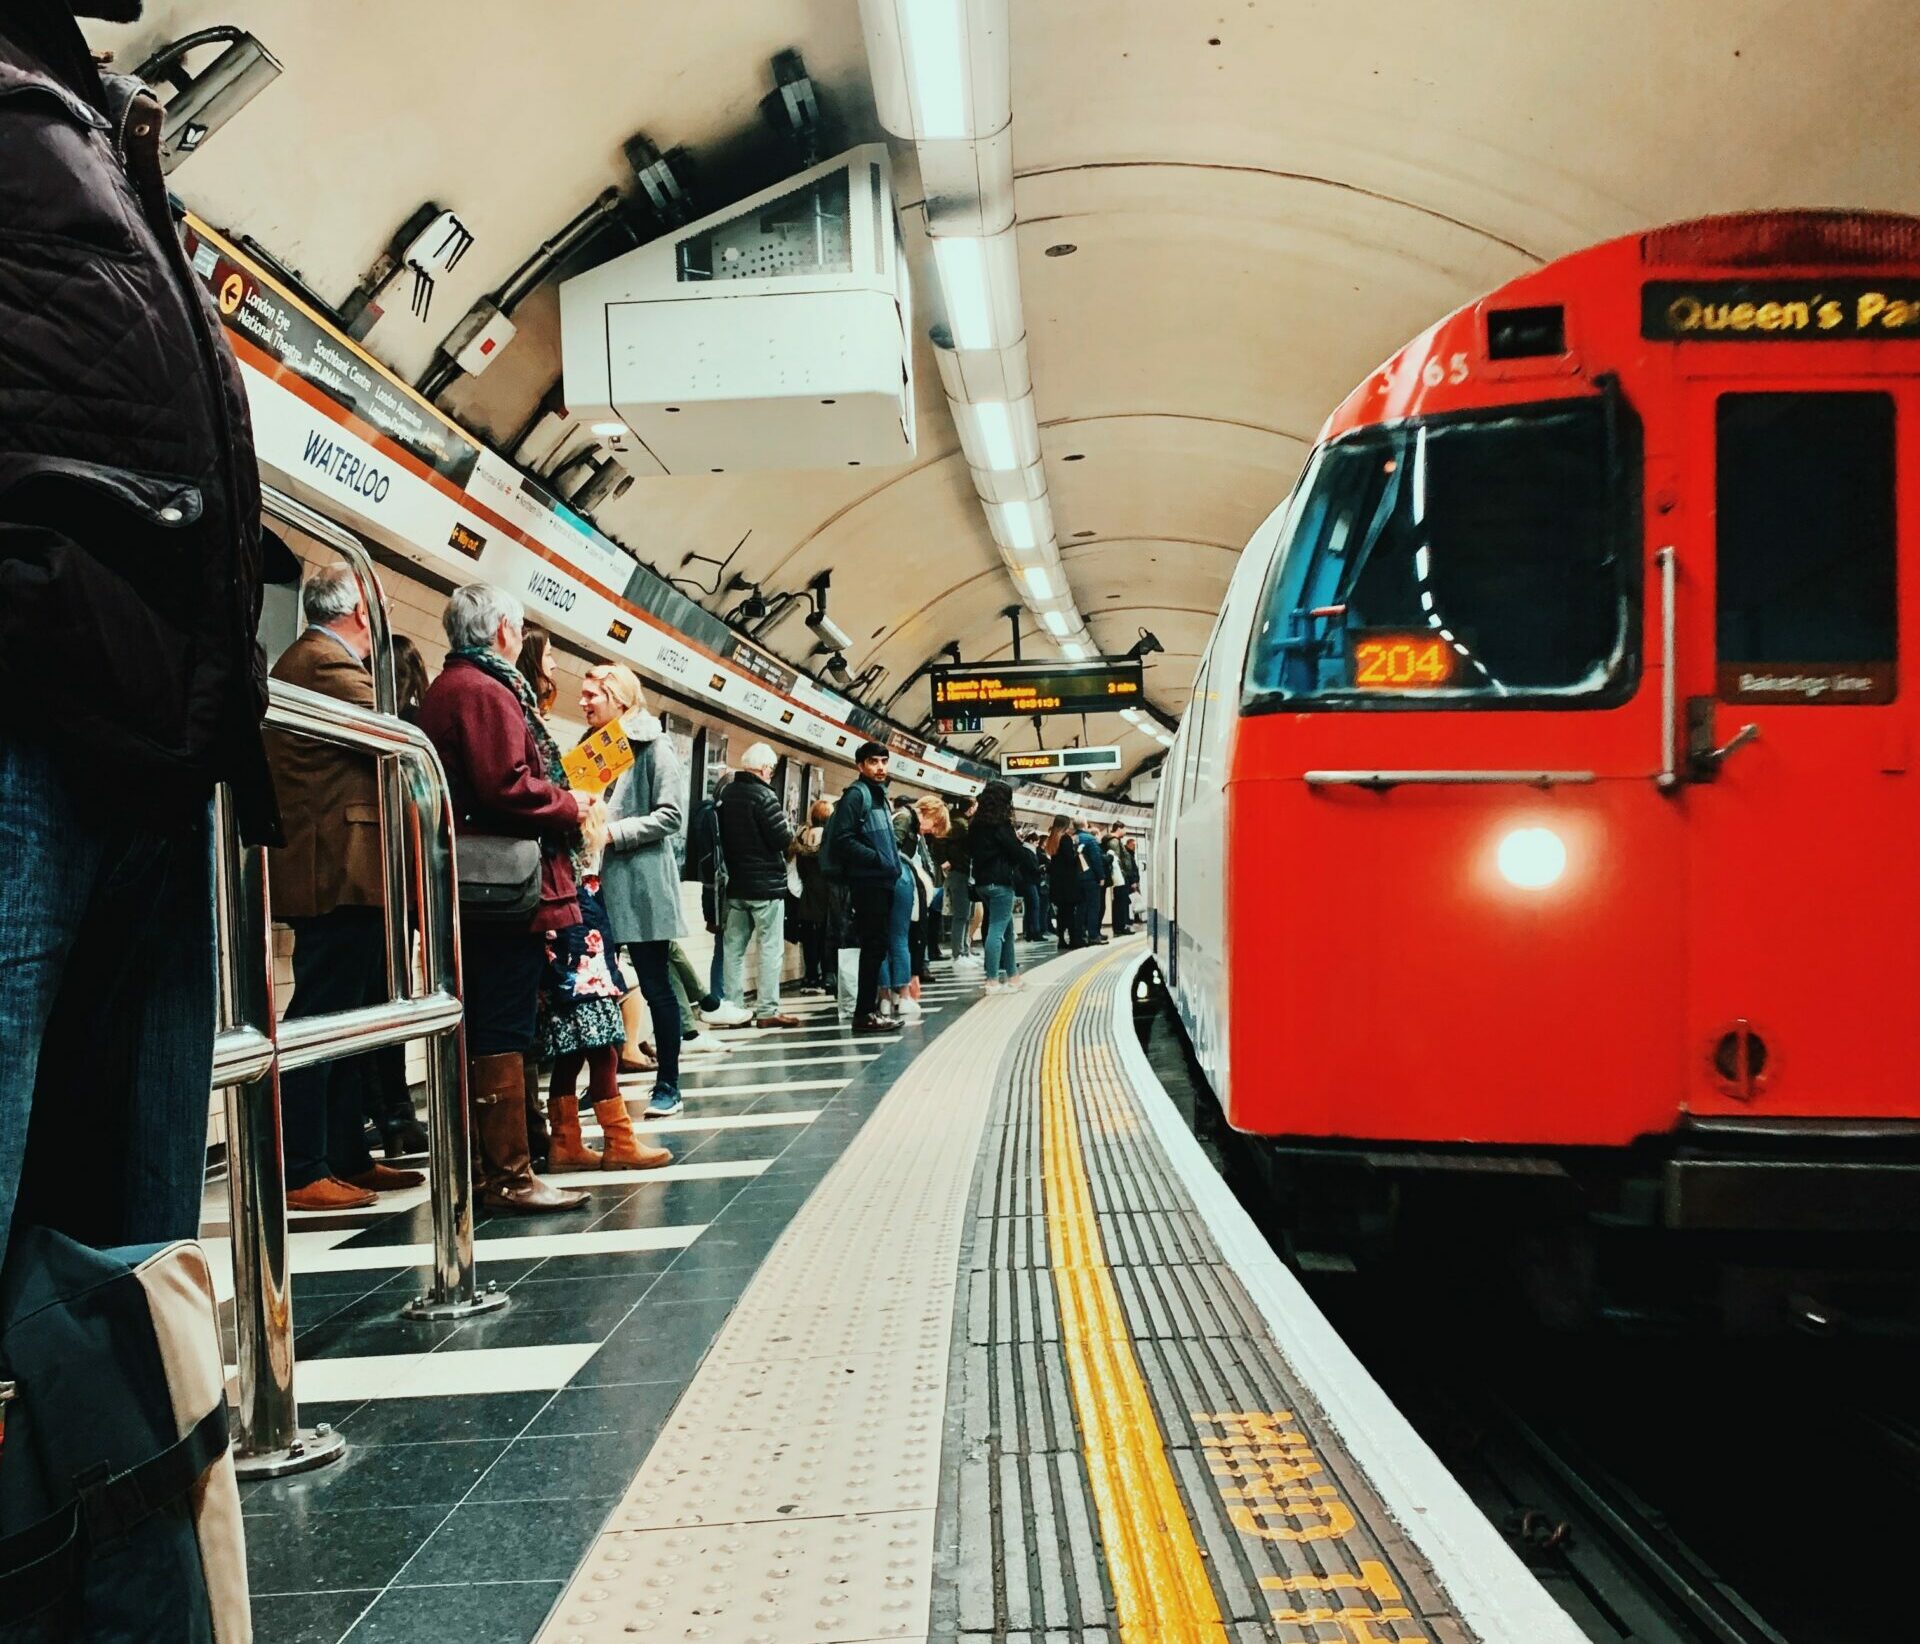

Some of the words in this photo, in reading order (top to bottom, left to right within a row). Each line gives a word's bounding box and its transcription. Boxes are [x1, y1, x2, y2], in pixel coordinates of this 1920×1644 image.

[238, 307, 274, 343] National
[245, 287, 276, 320] London
[275, 310, 290, 332] Eye
[1668, 294, 1844, 331] Queen's
[303, 430, 390, 503] WATERLOO
[528, 569, 576, 612] WATERLOO
[1358, 645, 1444, 682] 204
[1016, 757, 1034, 767] Way
[1034, 756, 1050, 765] out
